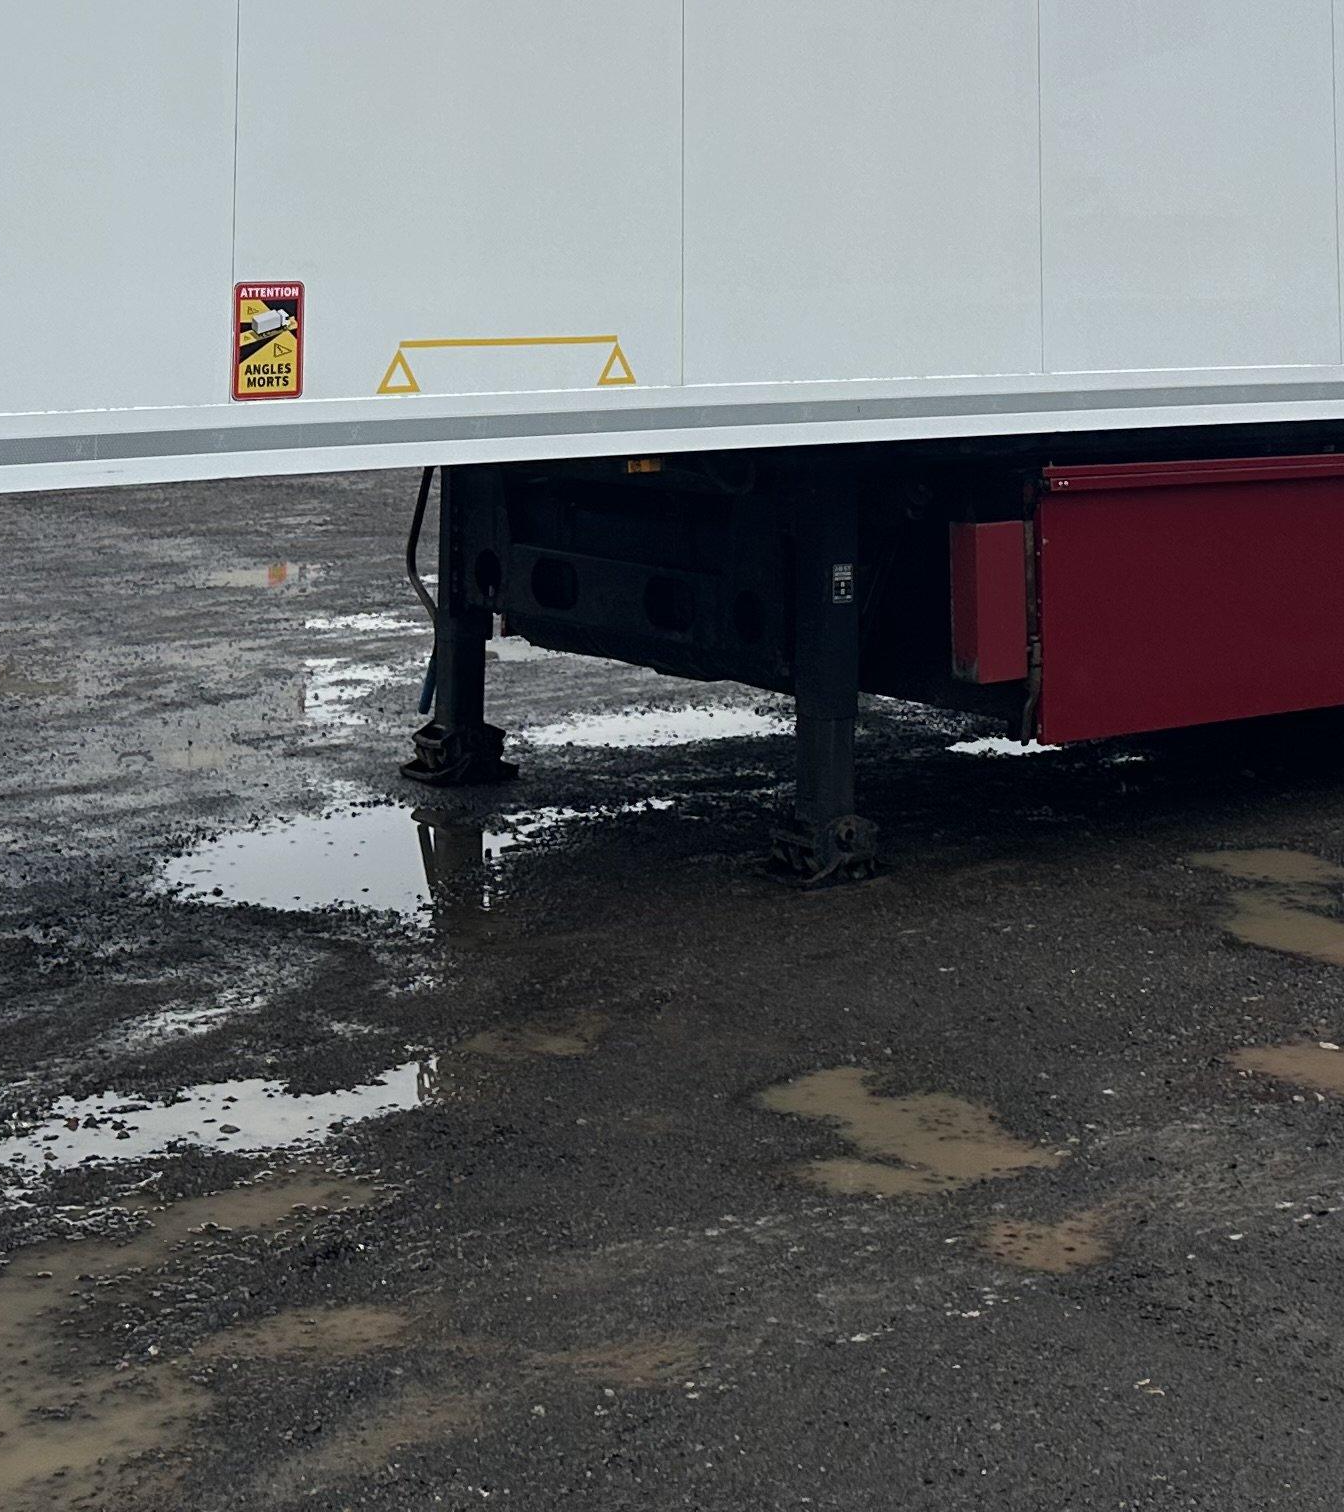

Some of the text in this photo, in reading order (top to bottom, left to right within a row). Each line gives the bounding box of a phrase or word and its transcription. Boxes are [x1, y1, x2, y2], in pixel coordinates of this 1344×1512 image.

[240, 287, 299, 298] ATTENTION
[245, 363, 292, 375] ANGLES
[247, 376, 289, 388] MORTS
